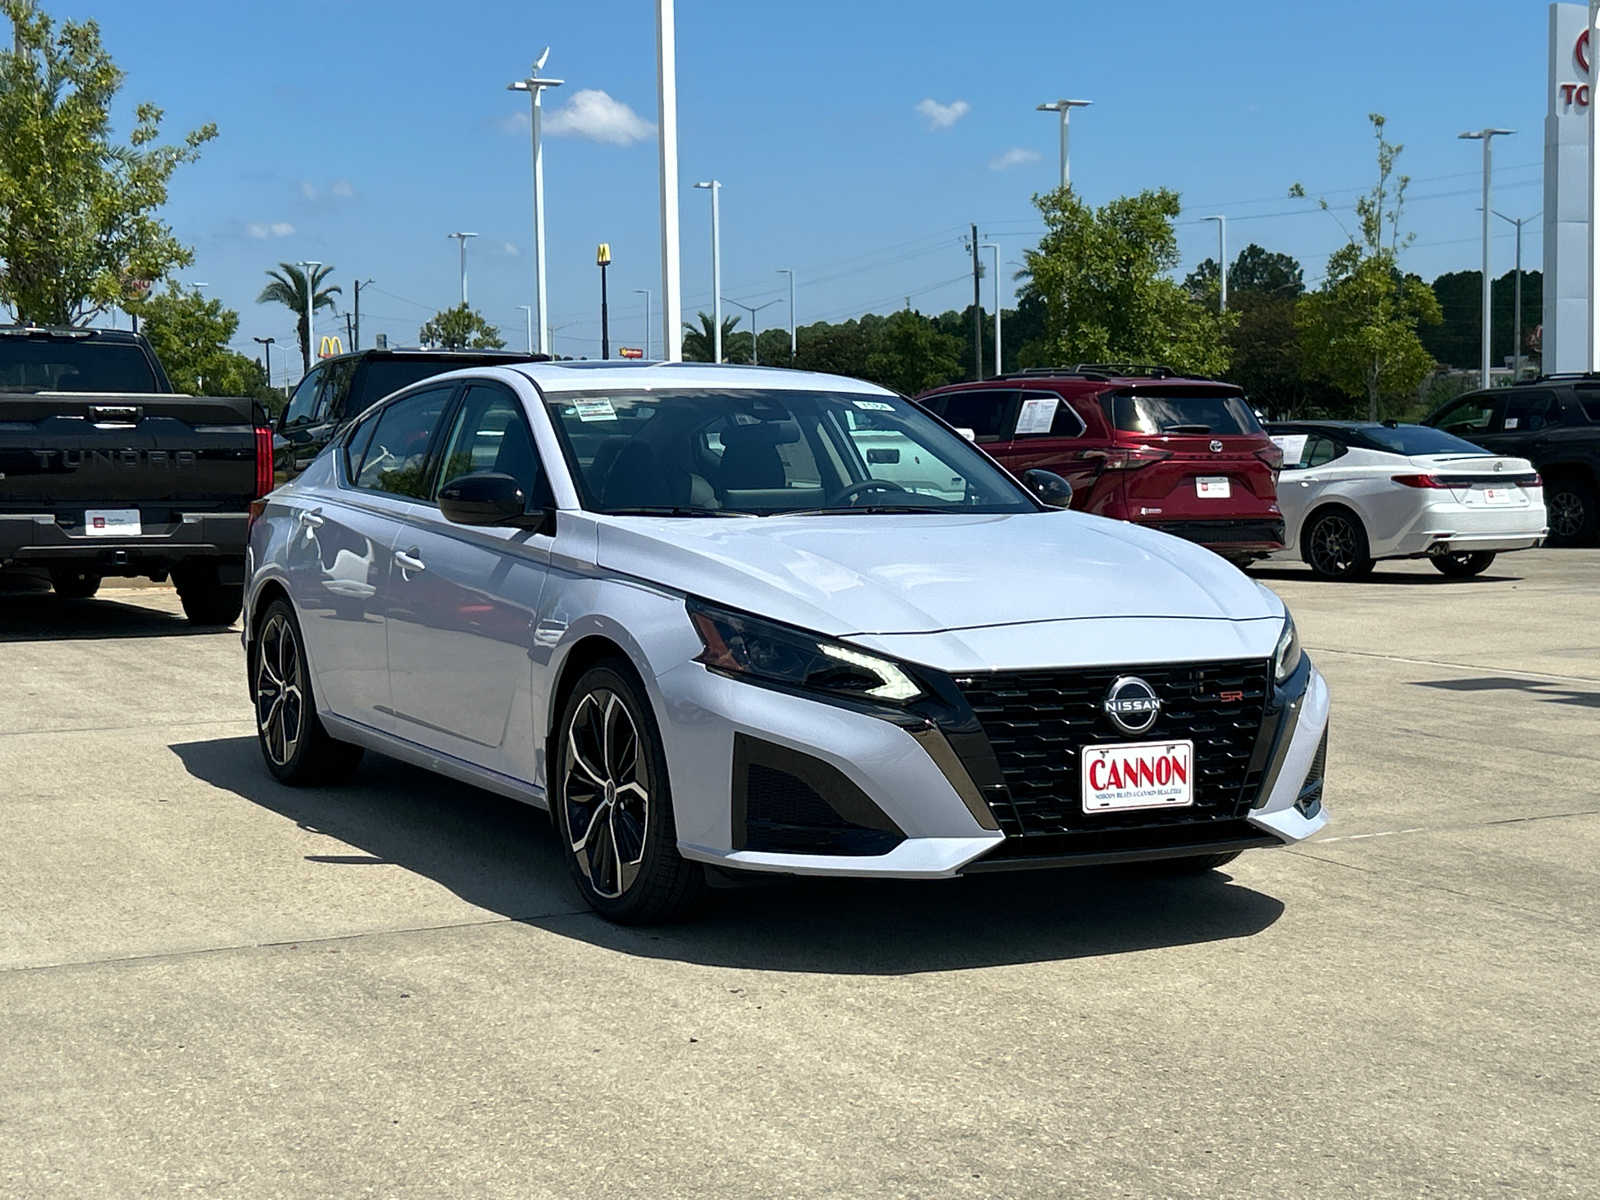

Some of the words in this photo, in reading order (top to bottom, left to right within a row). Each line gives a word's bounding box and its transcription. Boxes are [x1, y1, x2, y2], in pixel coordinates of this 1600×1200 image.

[33, 450, 196, 469] TUNDRA
[1220, 690, 1244, 702] SR
[1105, 700, 1160, 711] NISSAN
[1089, 755, 1187, 791] CANNON
